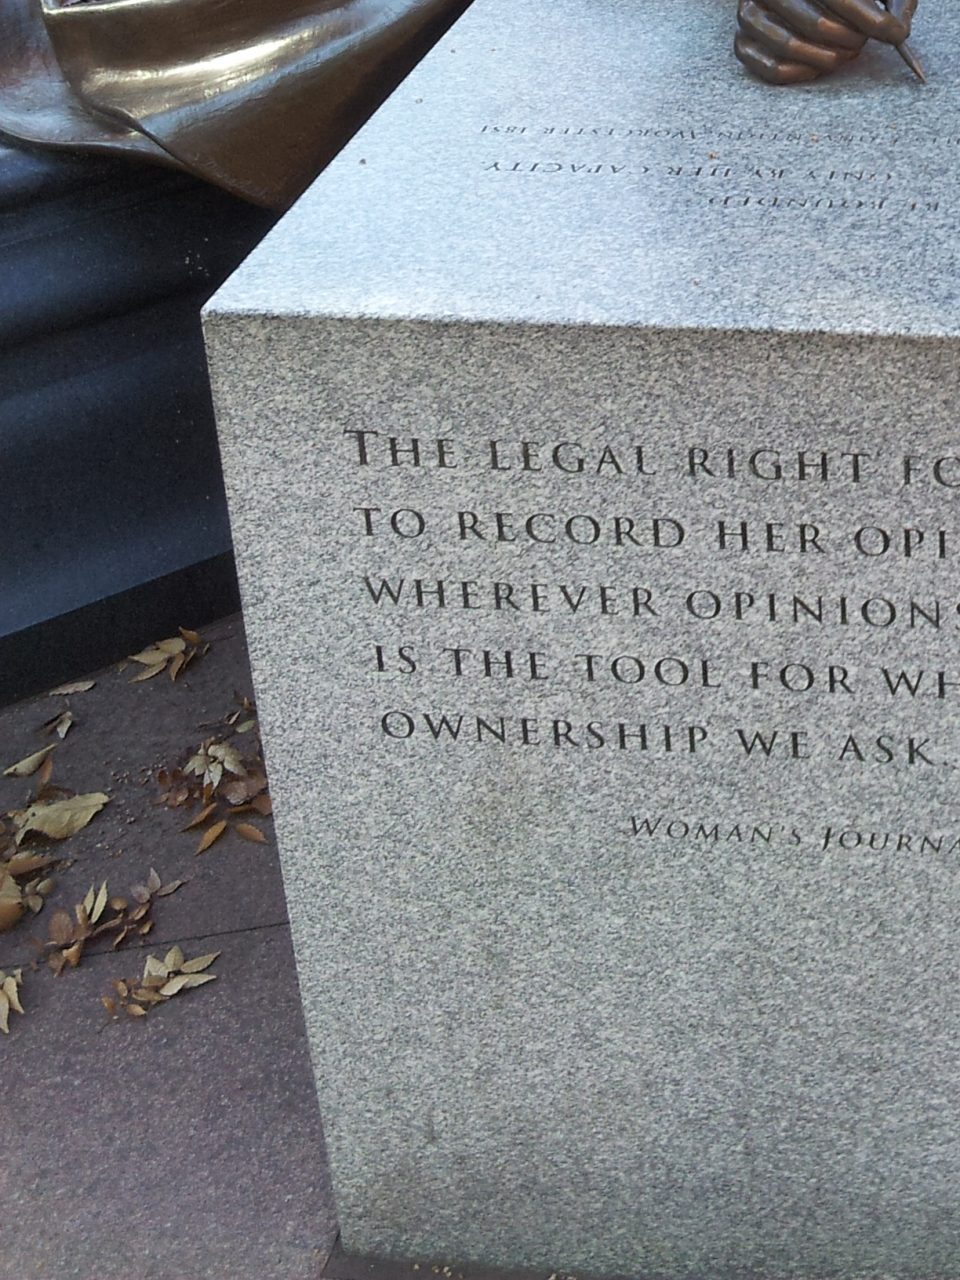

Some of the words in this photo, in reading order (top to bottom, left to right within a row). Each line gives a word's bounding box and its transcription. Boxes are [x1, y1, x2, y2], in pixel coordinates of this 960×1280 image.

[666, 165, 733, 178] HER
[708, 196, 885, 210] BOUNDED
[343, 429, 457, 469] THE
[488, 440, 658, 477] LEGAL
[687, 446, 870, 483] RIGHT
[353, 507, 426, 539] TO
[457, 510, 685, 548] RECORD
[717, 521, 826, 553] HER
[363, 577, 659, 616] WHEREVER
[375, 645, 418, 674] IS
[443, 647, 549, 680] THE
[574, 653, 722, 688] TOOL
[750, 661, 854, 695] FOR
[381, 711, 708, 754] OWNERSHIP
[736, 728, 809, 760] WE
[838, 734, 948, 767] ASK.
[627, 816, 802, 847] WOMAN'S
